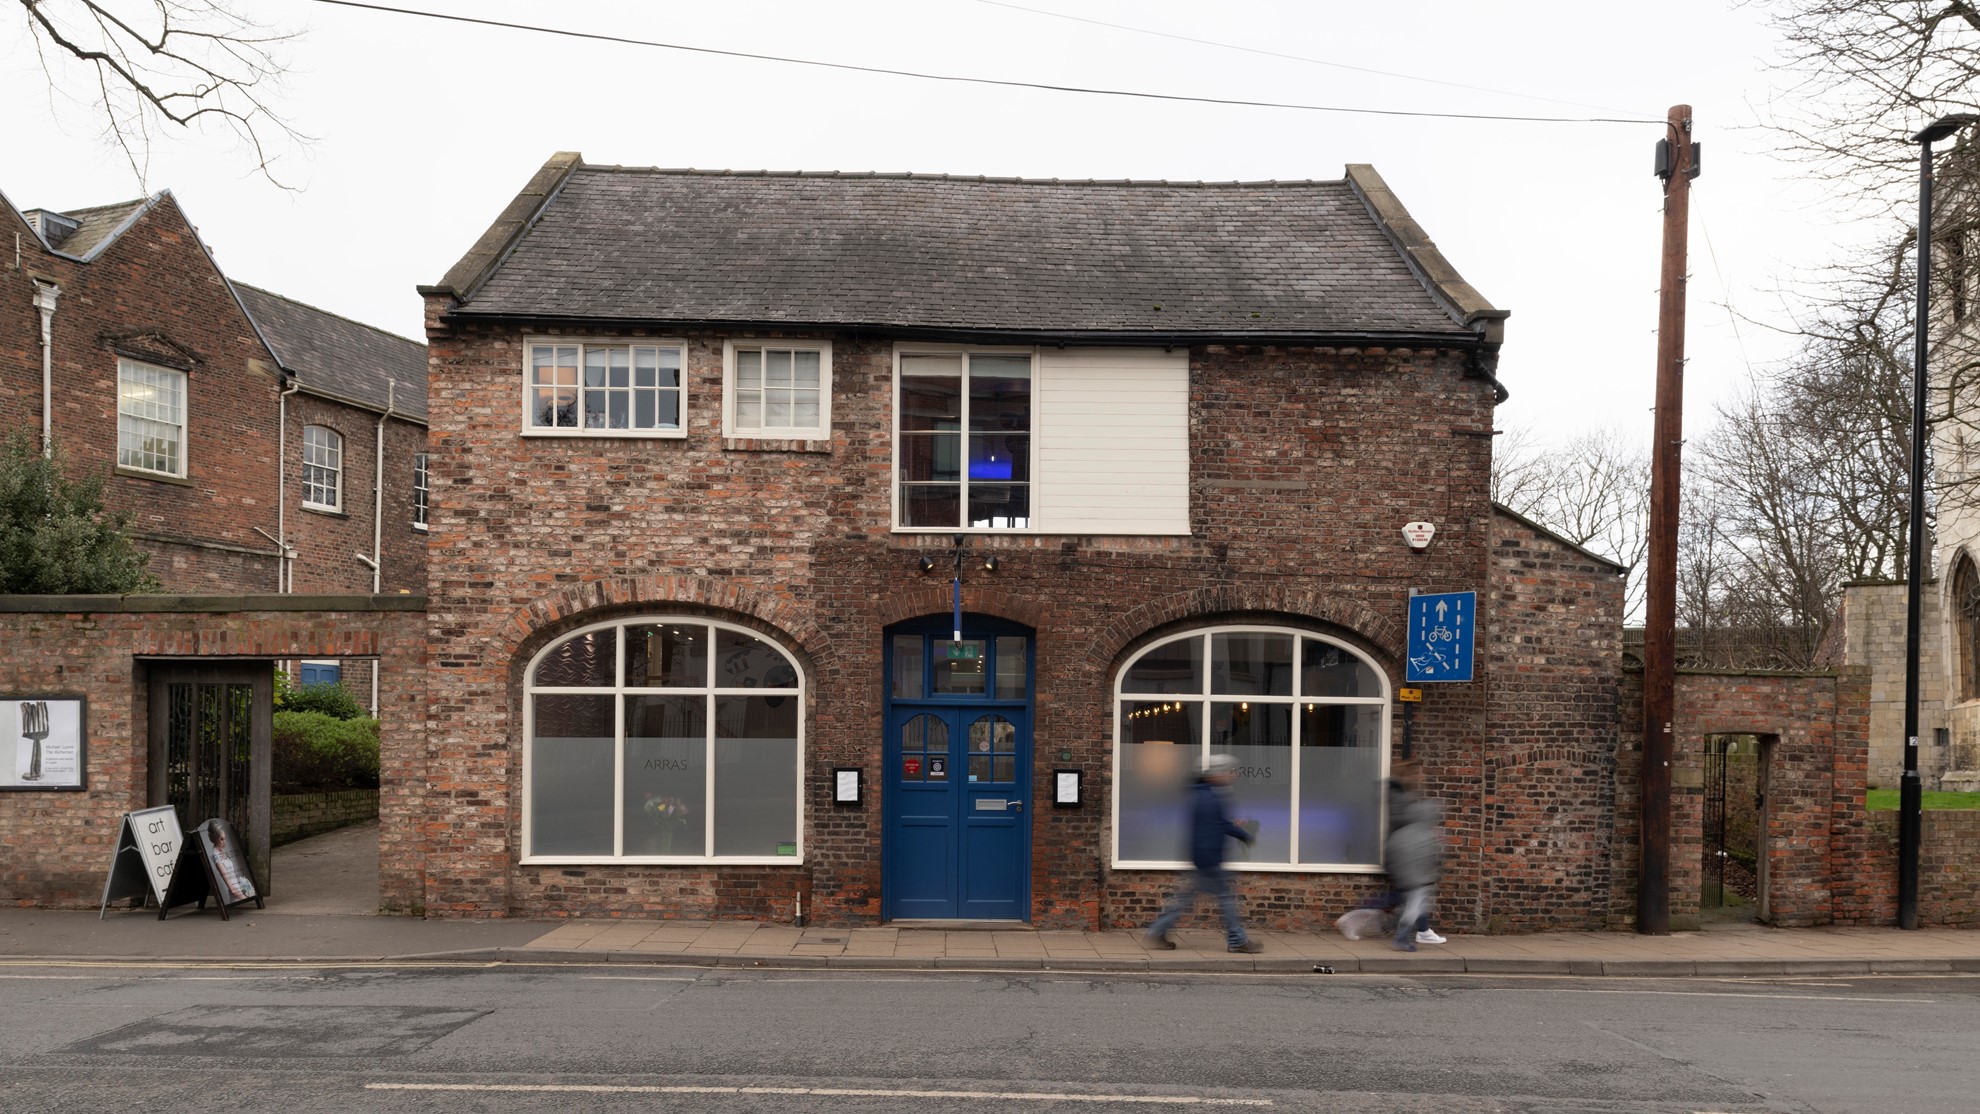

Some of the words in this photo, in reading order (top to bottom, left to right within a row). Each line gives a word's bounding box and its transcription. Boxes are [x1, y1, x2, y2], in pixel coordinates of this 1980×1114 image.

[644, 759, 688, 770] ARRAS
[1231, 767, 1272, 778] ARRAS
[148, 818, 165, 834] art
[151, 841, 173, 855] bar
[156, 859, 175, 877] caf
